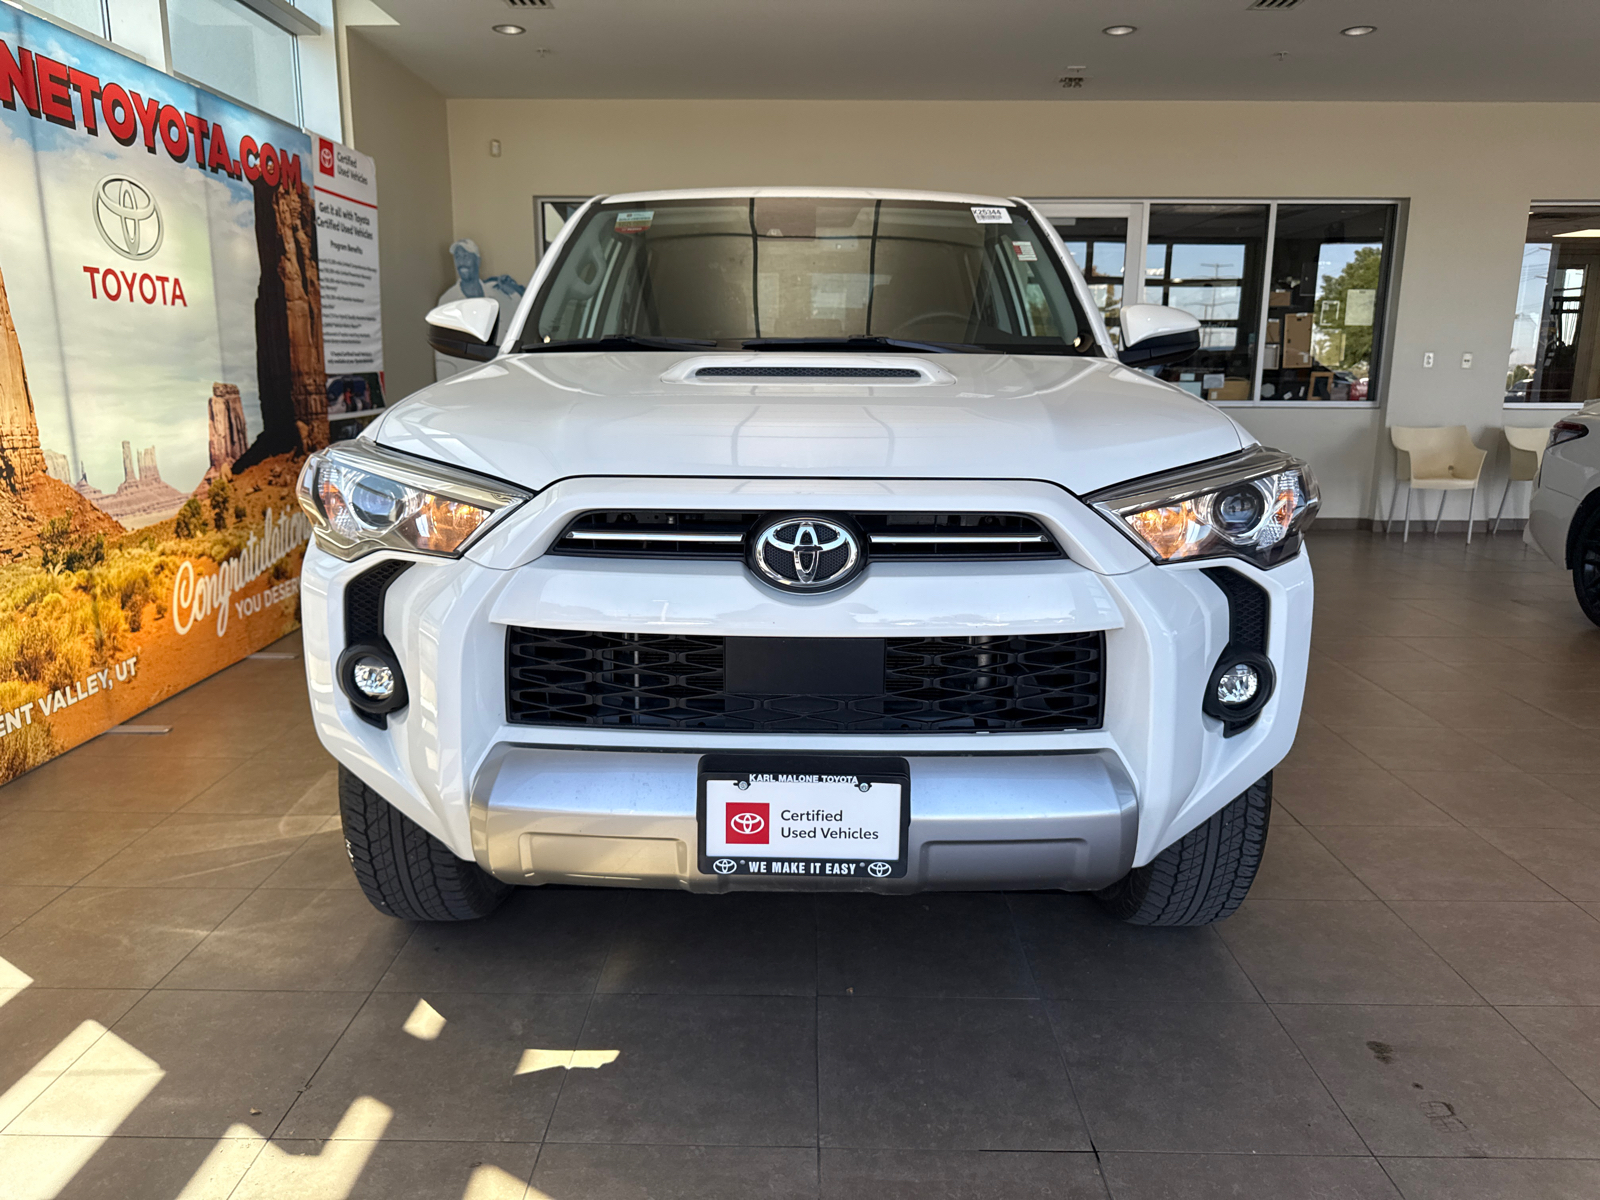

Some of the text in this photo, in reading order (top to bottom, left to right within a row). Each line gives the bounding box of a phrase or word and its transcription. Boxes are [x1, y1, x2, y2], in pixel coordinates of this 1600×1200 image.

[337, 152, 358, 169] Certified
[337, 165, 368, 185] Used Vehicles
[319, 202, 330, 214] Get
[342, 209, 354, 221] with
[354, 211, 370, 226] Toyota
[316, 216, 373, 240] Certified Used Vehicles
[83, 265, 188, 307] TOYOTA
[172, 504, 311, 637] Congratulation
[235, 593, 261, 619] YOU
[38, 668, 113, 717] VALLEY,
[115, 657, 137, 681] UT
[749, 774, 859, 785] KARL MALONE TOYOTA
[780, 809, 843, 822] Certified
[781, 827, 879, 840] Used Vehicles
[749, 861, 856, 875] WE MAKE IT EASY
